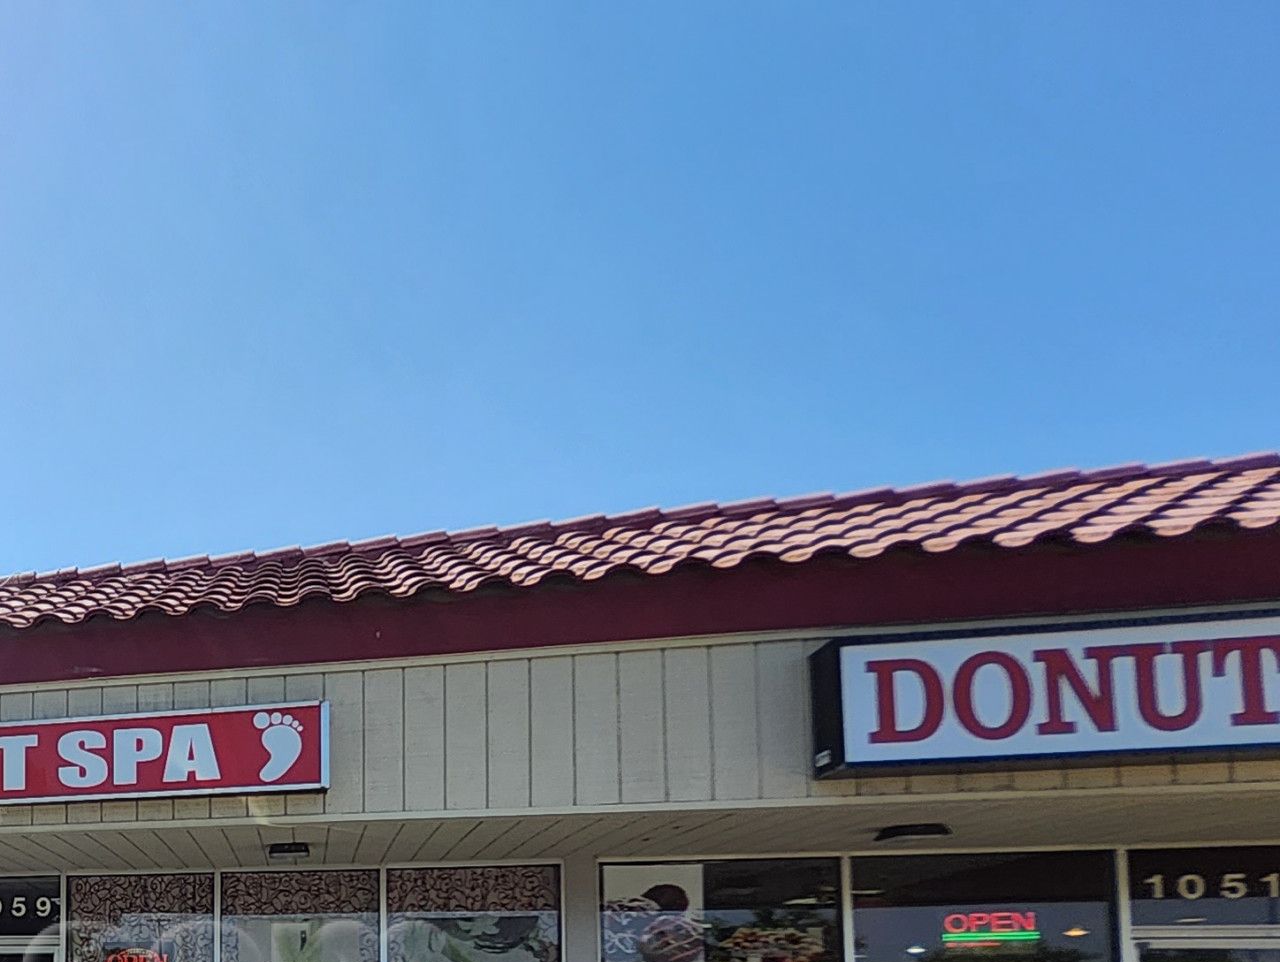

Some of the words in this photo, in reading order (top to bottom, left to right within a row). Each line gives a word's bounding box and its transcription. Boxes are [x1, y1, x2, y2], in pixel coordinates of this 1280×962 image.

[57, 723, 221, 789] SPA
[1143, 873, 1280, 899] 1051
[943, 911, 1036, 932] OPEN
